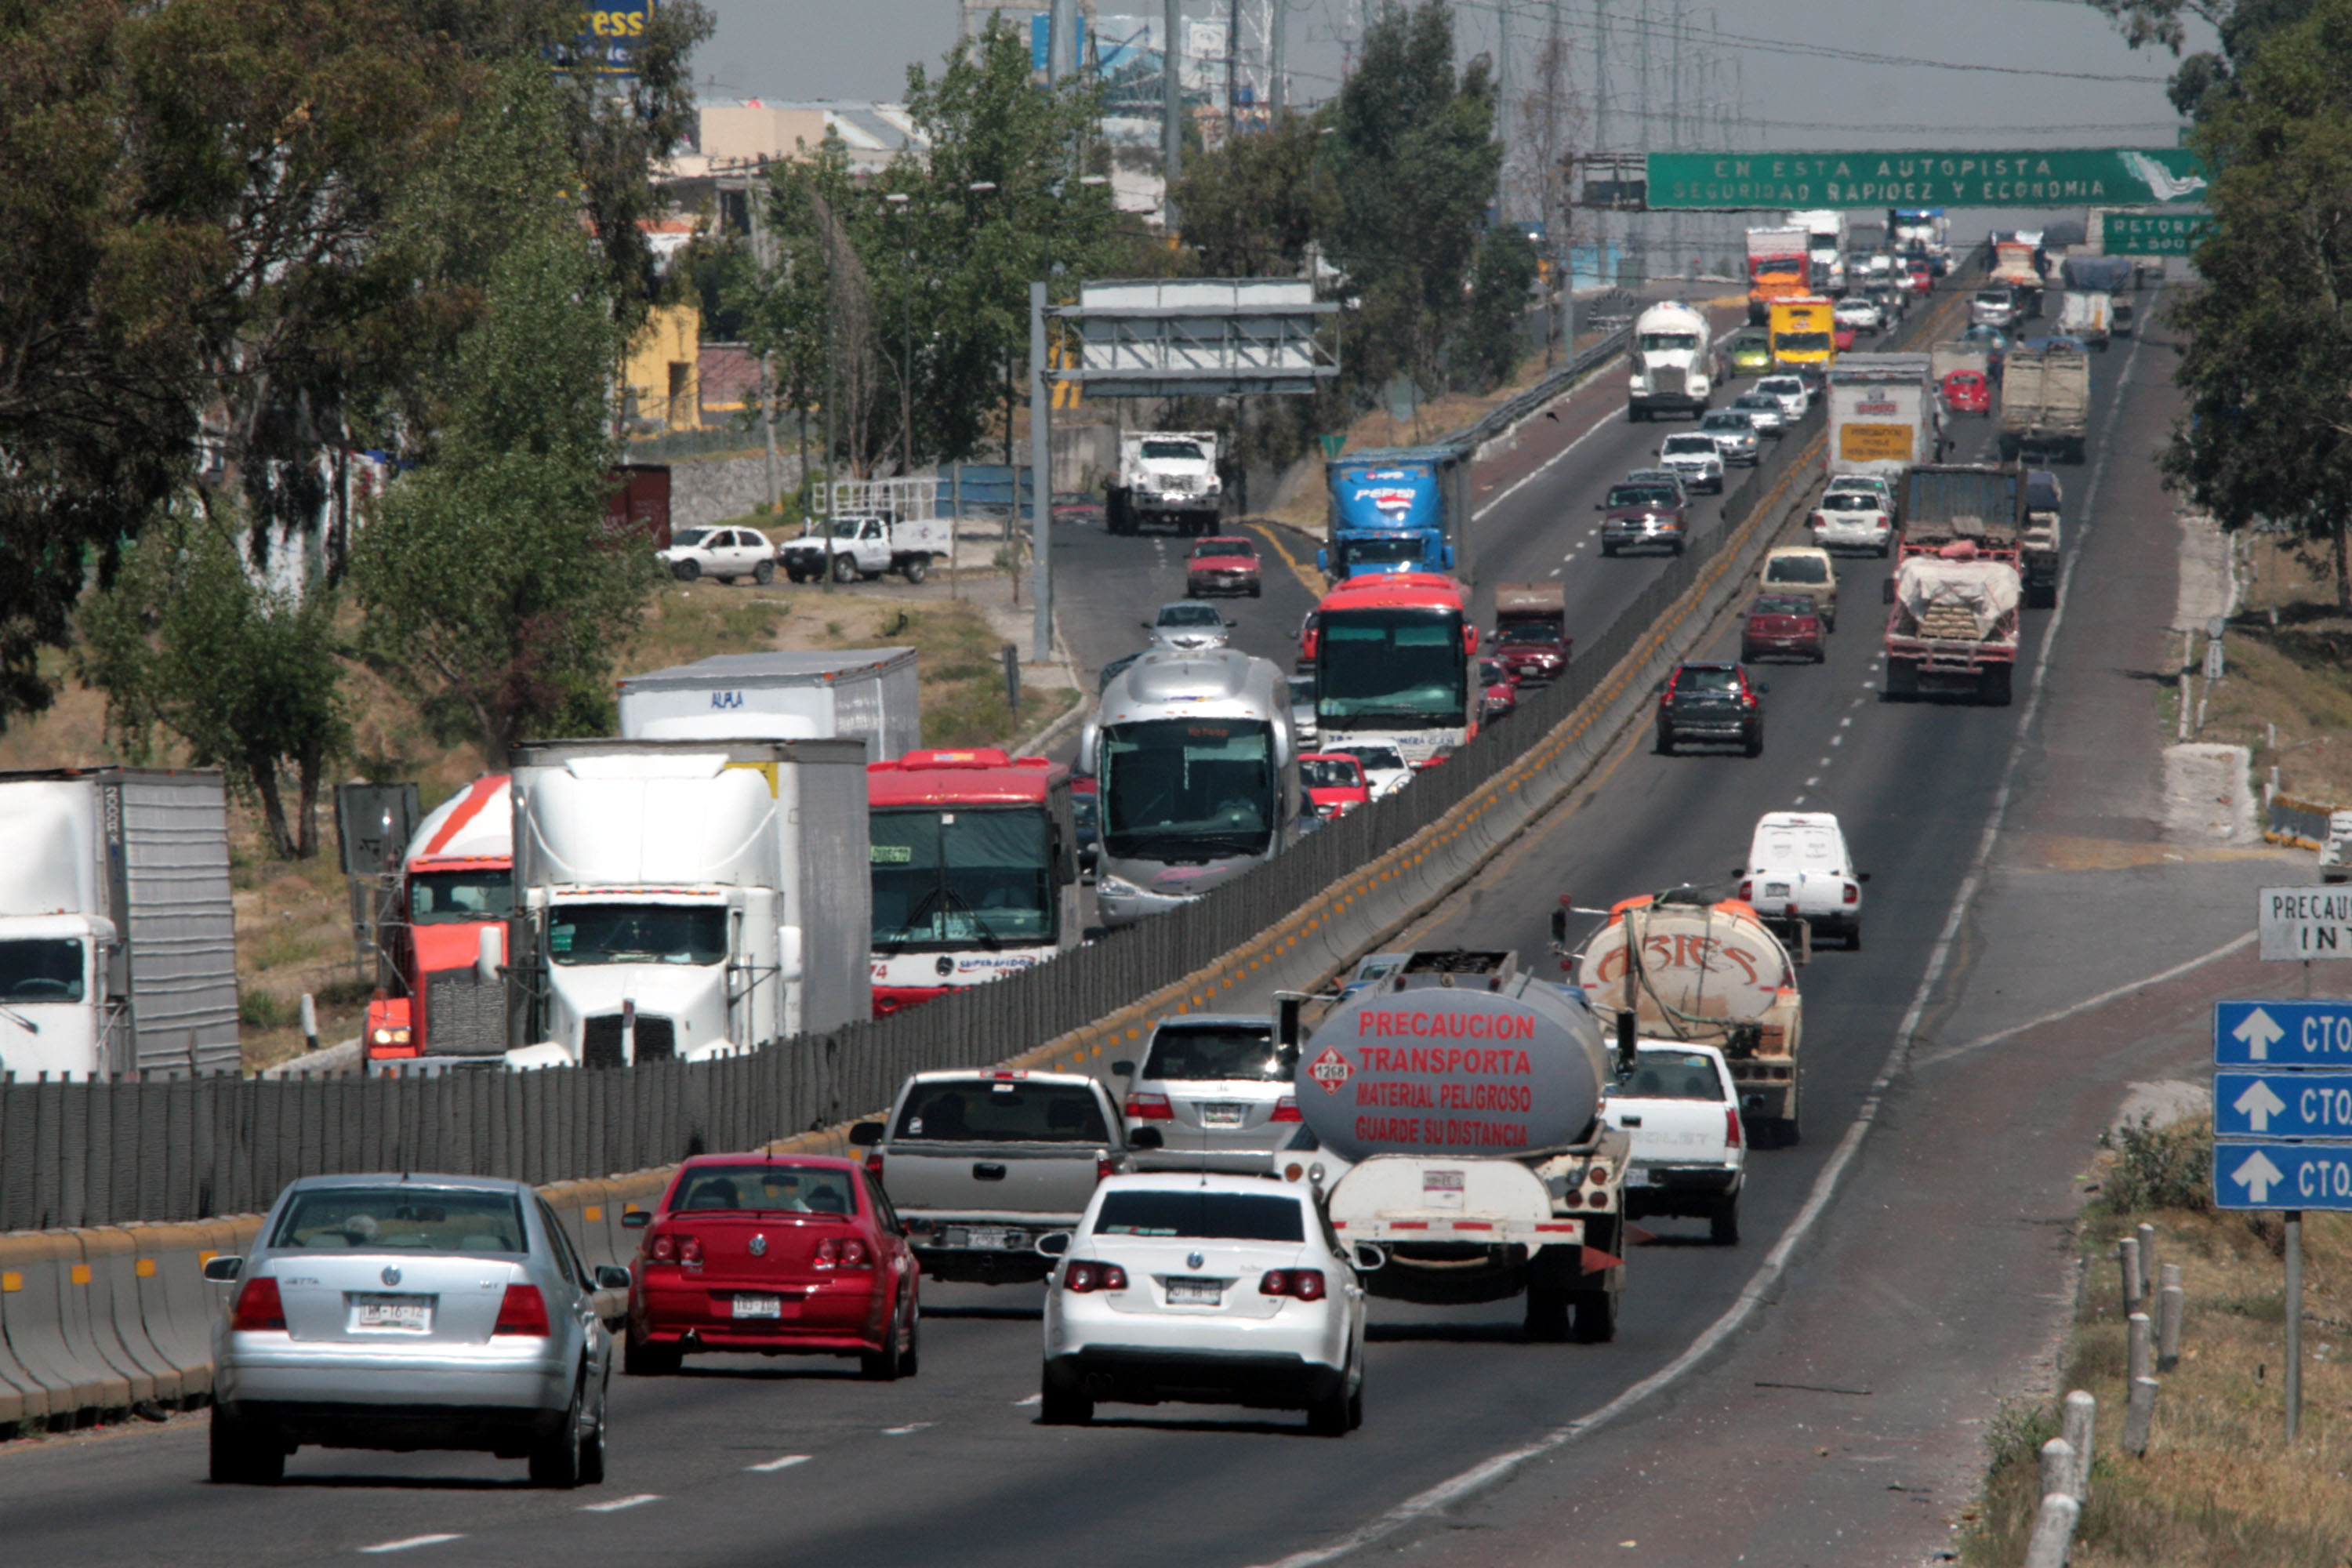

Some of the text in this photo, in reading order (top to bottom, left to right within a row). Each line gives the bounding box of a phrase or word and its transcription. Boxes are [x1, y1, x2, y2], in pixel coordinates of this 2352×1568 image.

[1715, 159, 2052, 177] EN ESTA AUTOPISTA
[1674, 180, 2106, 201] SEGURIDAD RAPIDEZ Y ECONOMIA
[2273, 895, 2352, 920] PRECAU
[1358, 1011, 1535, 1040] PRECAUCION
[1316, 1065, 1345, 1078] 1268
[1357, 1047, 1532, 1075] TRANSPORTA
[1327, 1081, 1336, 1091] 3
[1356, 1082, 1532, 1112] MATERIAL PELIGROSO
[1355, 1116, 1528, 1148] GUARDE SU DISTANCIA
